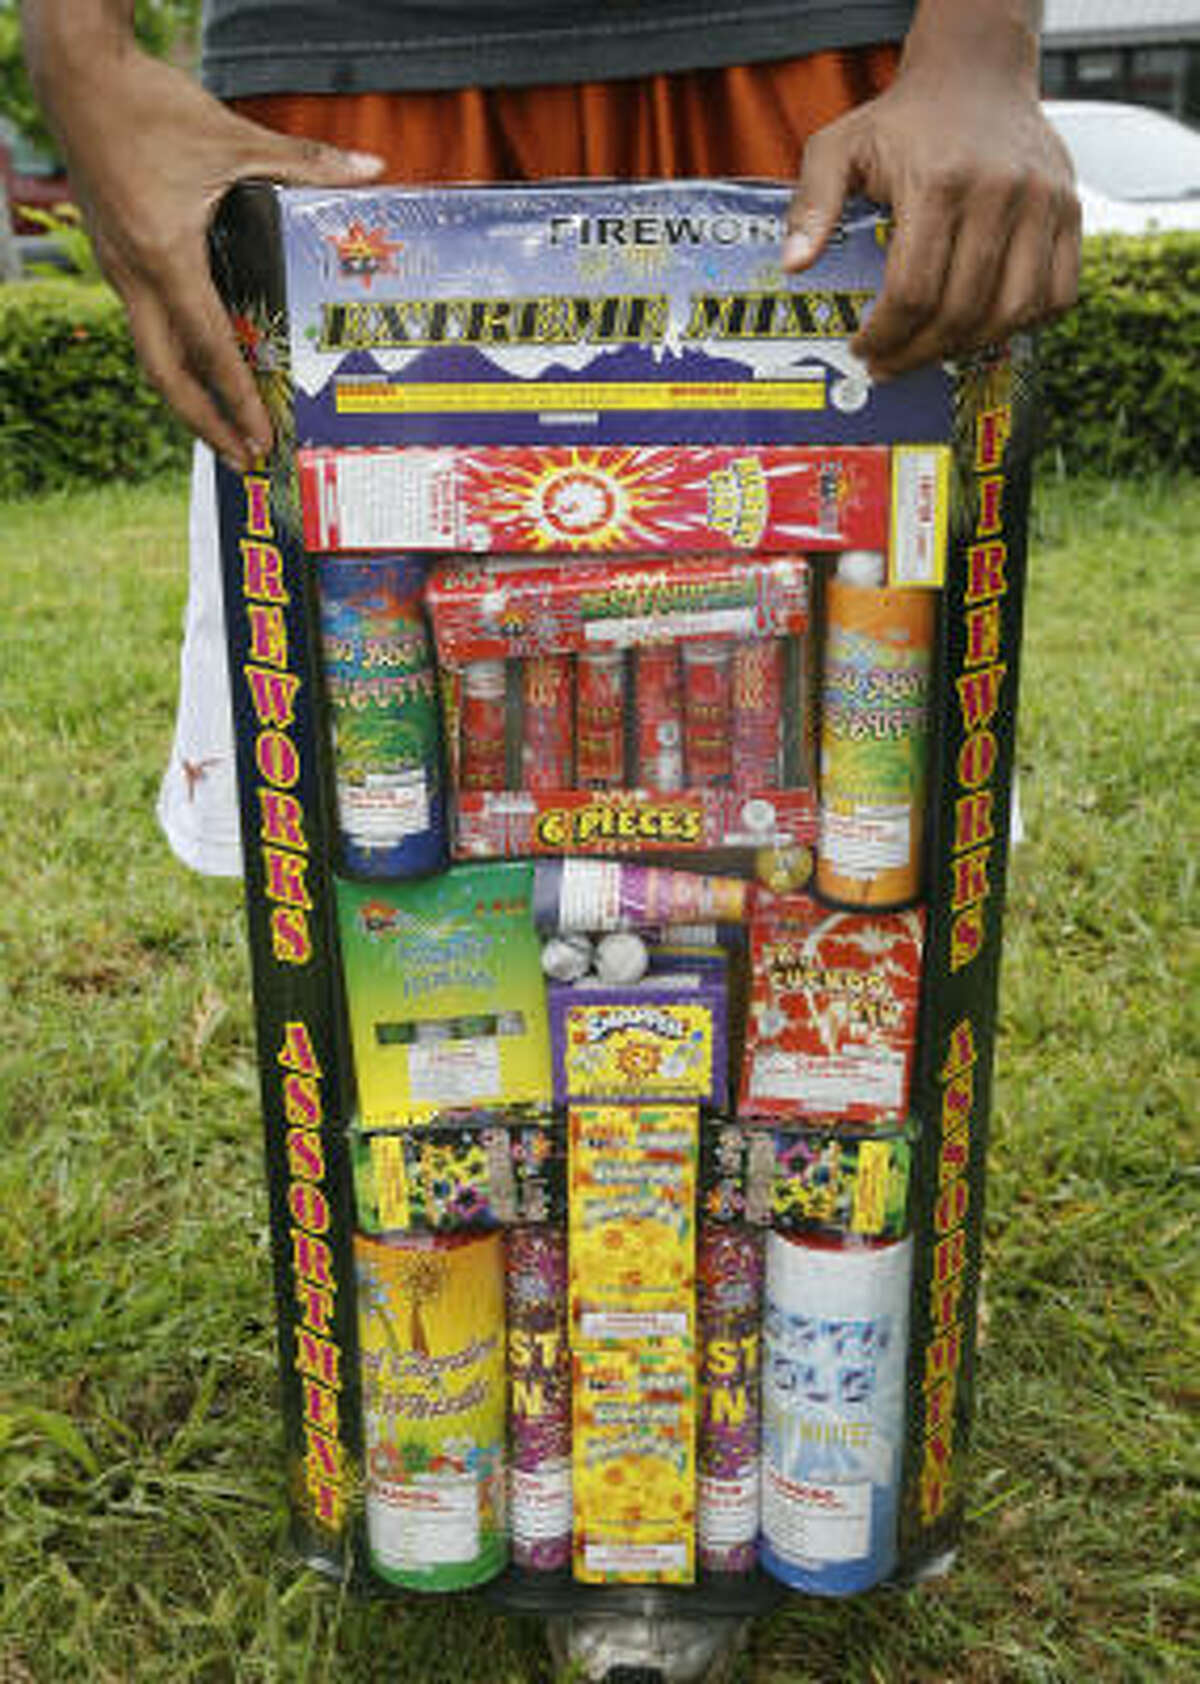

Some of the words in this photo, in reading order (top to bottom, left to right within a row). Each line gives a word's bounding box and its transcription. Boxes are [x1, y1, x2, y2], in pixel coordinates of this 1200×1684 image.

[317, 294, 669, 352] EXTREME
[550, 216, 849, 246] FIREWORS
[239, 456, 312, 966] IREWORKS
[537, 806, 567, 847] 6
[573, 803, 702, 847] PIECES
[950, 404, 1012, 975] FIREWORKS
[277, 1020, 344, 1532] ASSORTMENT
